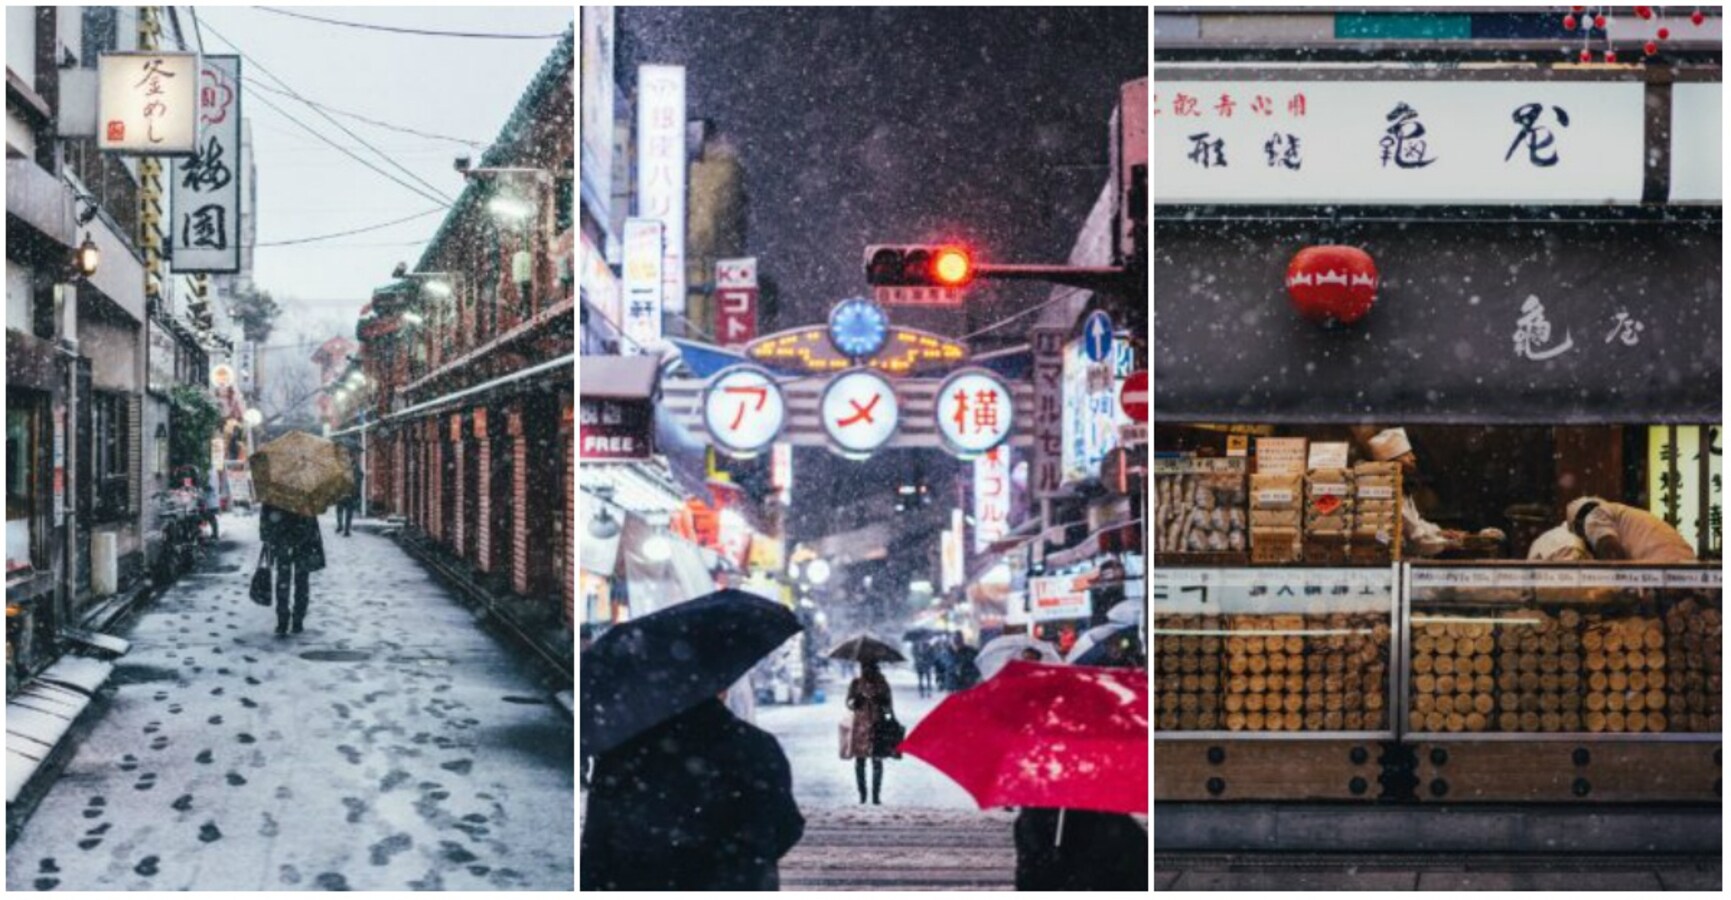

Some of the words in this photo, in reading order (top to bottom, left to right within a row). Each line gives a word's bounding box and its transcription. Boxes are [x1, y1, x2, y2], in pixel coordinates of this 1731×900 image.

[724, 385, 998, 434] アメ横
[584, 436, 634, 454] FREE
